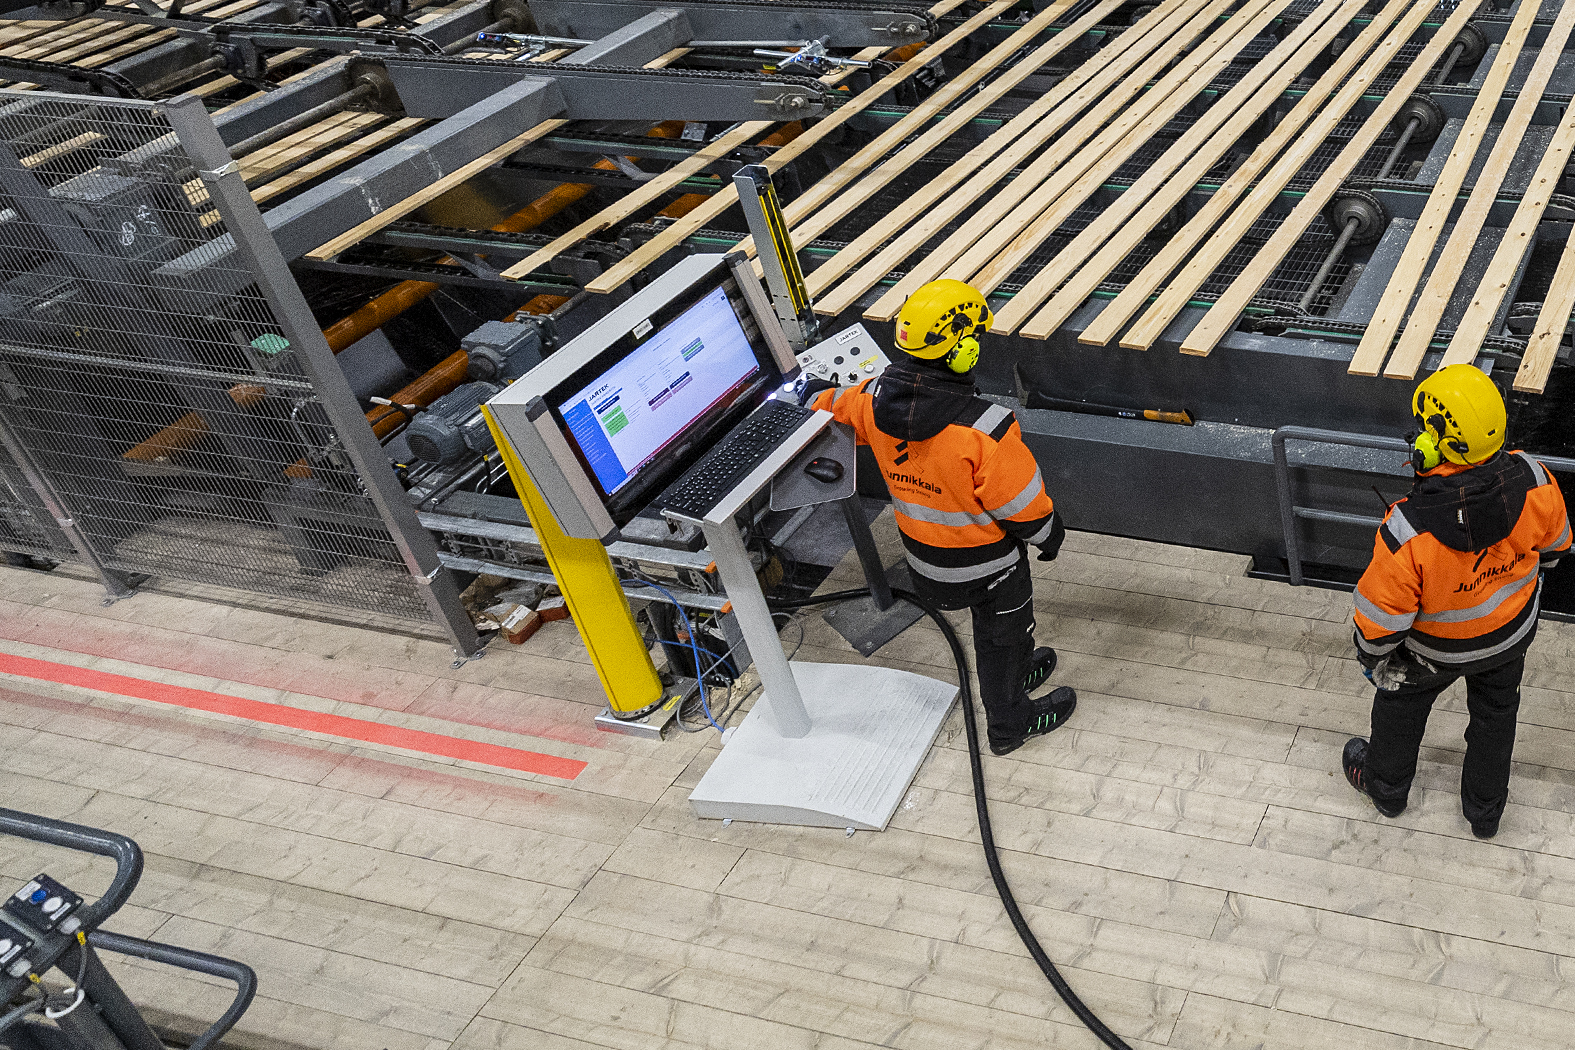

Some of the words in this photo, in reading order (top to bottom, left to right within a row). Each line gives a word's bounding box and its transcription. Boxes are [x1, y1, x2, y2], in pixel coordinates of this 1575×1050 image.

[839, 330, 858, 342] JARTEK
[588, 383, 609, 402] JARTEK
[886, 469, 942, 494] unnikkala
[1453, 552, 1526, 593] Junnikkala
